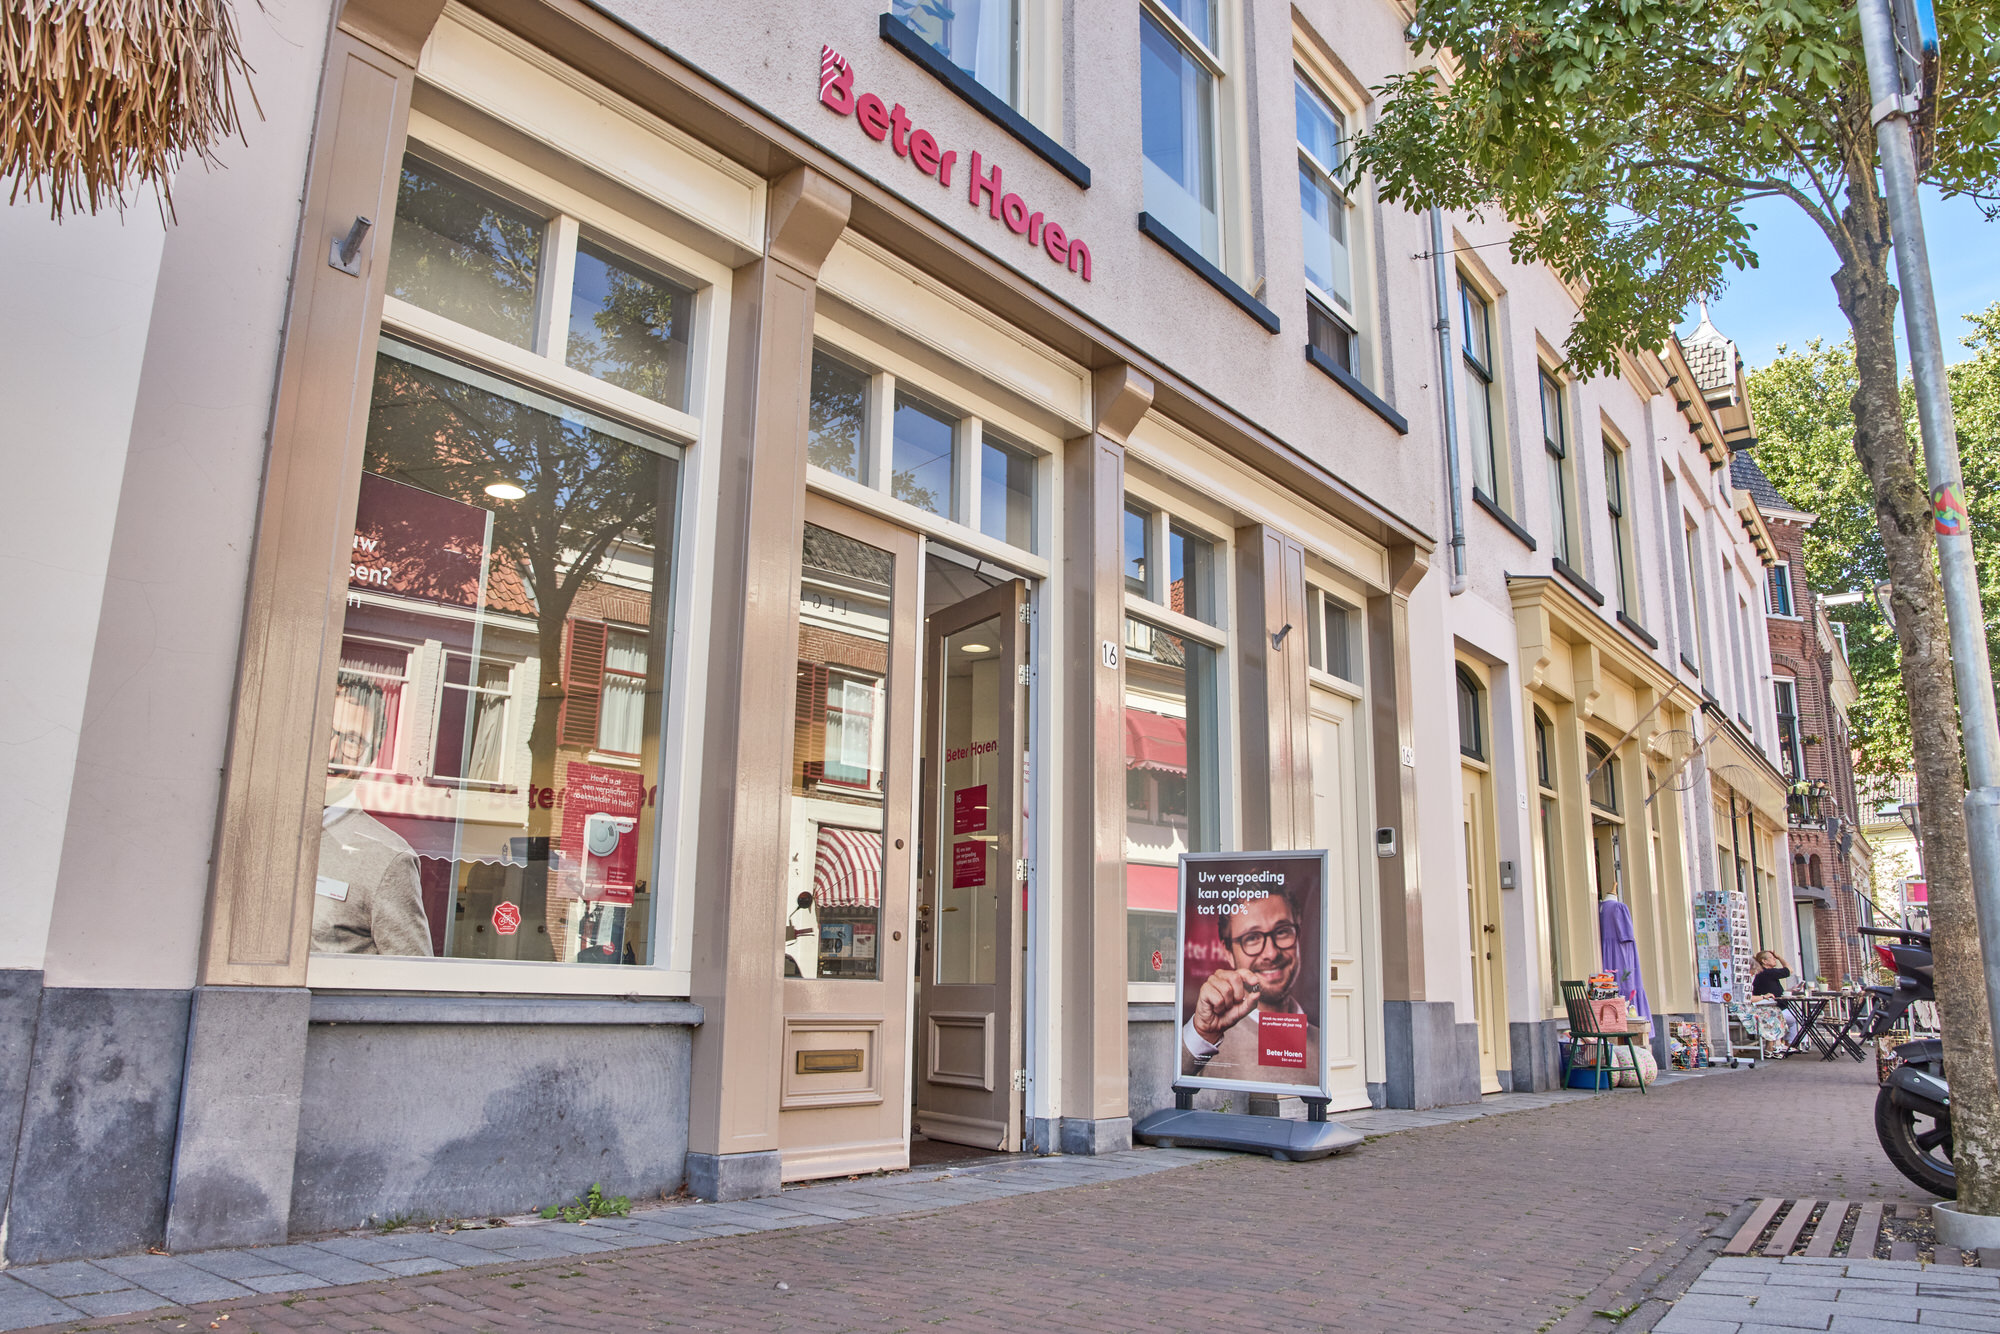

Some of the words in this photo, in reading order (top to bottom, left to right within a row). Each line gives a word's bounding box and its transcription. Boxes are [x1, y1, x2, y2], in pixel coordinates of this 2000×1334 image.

[820, 44, 957, 187] Beter
[970, 150, 1092, 282] Horen
[1103, 643, 1117, 666] 16
[946, 747, 969, 763] Beter
[970, 740, 997, 757] Horen
[590, 774, 608, 784] Heeft
[596, 786, 627, 796] verplichte
[1198, 871, 1216, 883] Uw
[1218, 870, 1285, 886] vergoeding
[1198, 887, 1219, 899] kan
[1221, 887, 1269, 902] oplopen
[1197, 904, 1215, 915] tot
[1266, 1049, 1283, 1057] Beter
[1284, 1050, 1303, 1058] Horen
